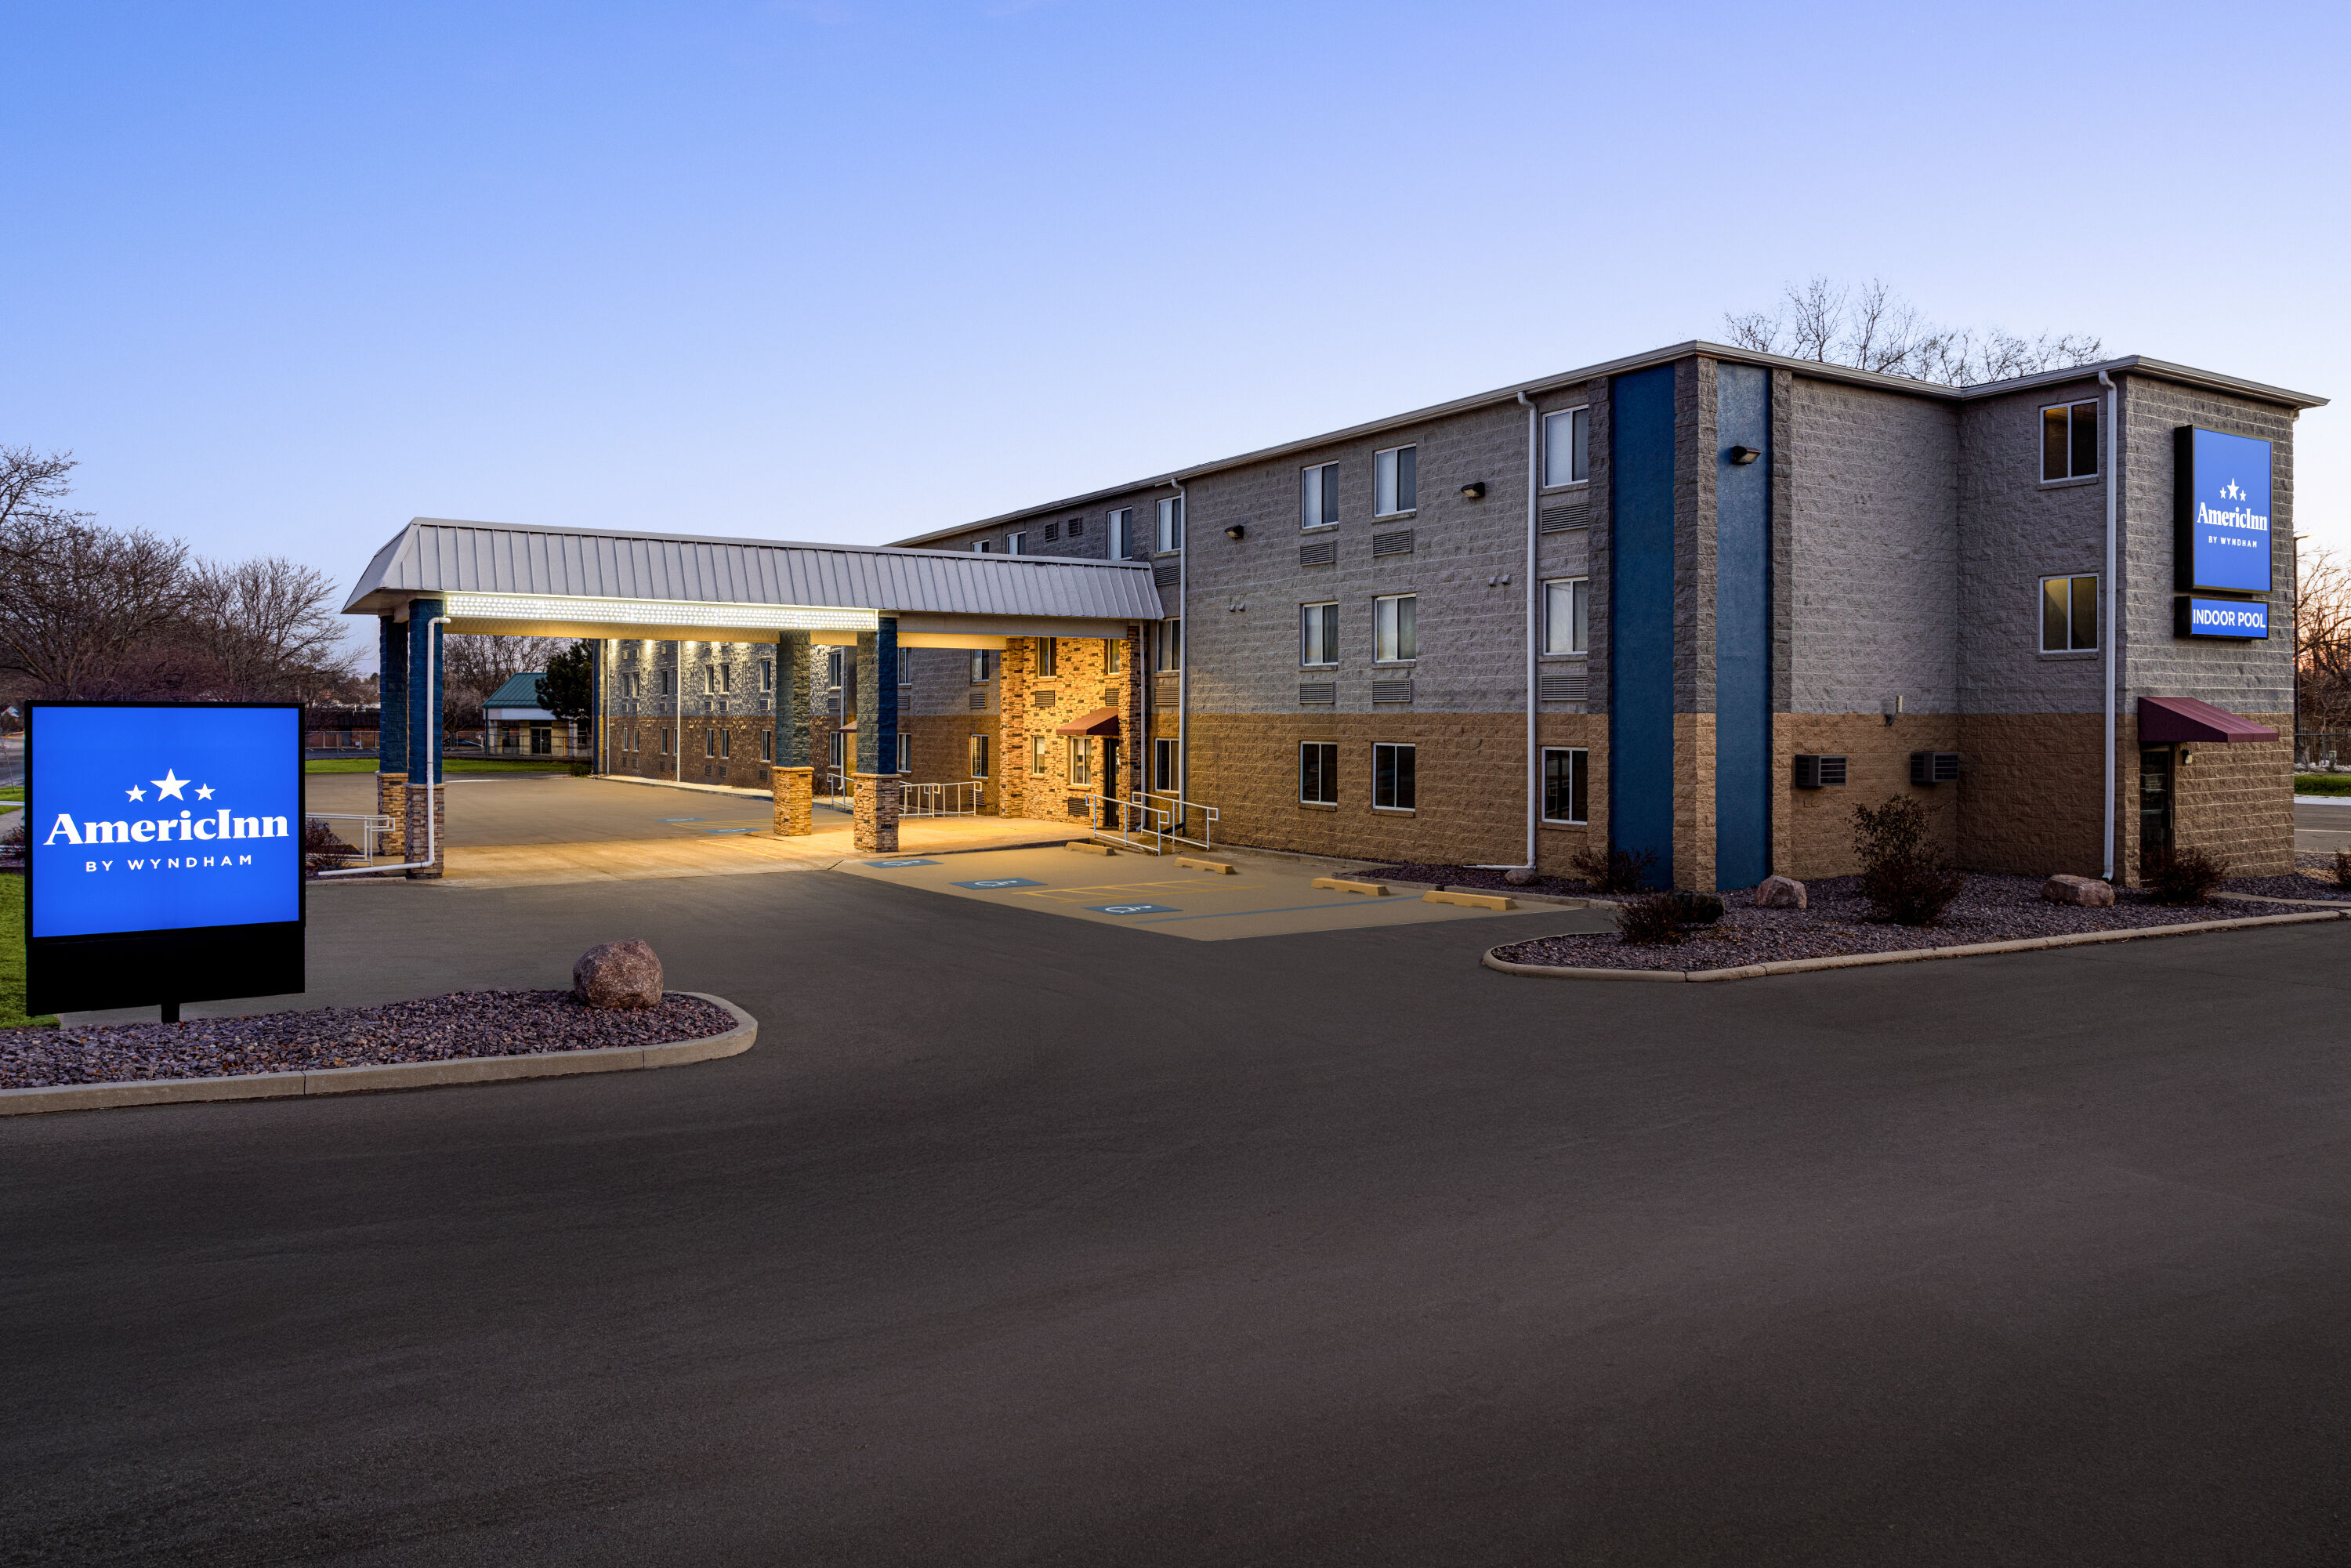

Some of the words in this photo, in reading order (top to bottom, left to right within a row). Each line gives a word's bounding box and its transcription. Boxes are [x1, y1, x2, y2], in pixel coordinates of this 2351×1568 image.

[2197, 502, 2268, 531] AmericInn
[2208, 535, 2218, 544] BY
[2220, 537, 2258, 549] WYNDHAM
[2193, 608, 2236, 626] INDOOR
[2237, 611, 2266, 628] POOL
[43, 809, 289, 846] AmericInn
[85, 860, 114, 872] BY
[127, 854, 252, 871] WYNDHAM
